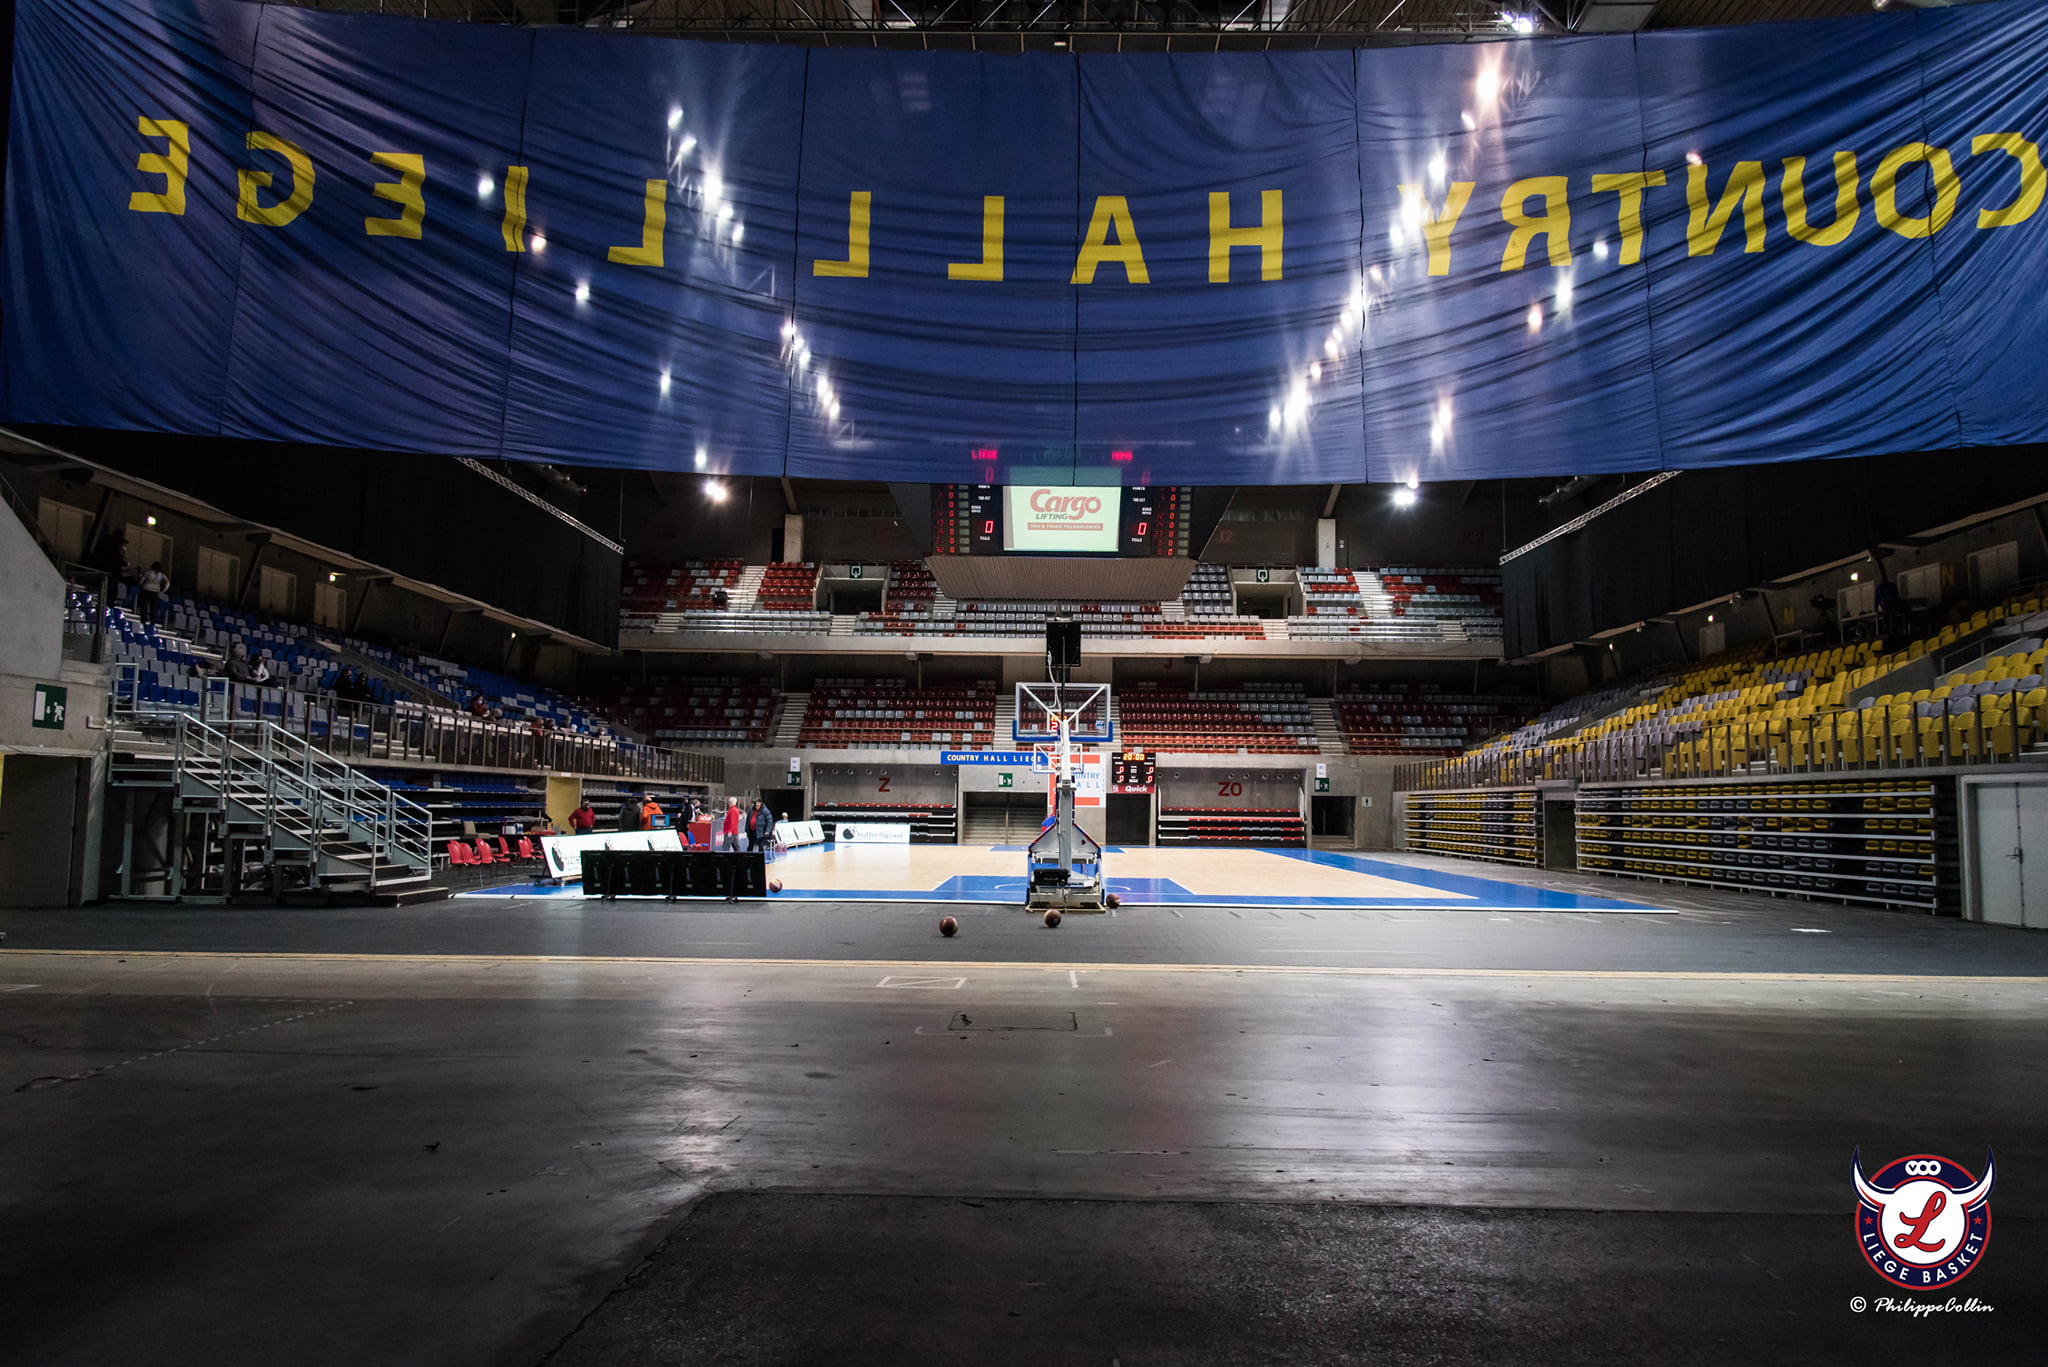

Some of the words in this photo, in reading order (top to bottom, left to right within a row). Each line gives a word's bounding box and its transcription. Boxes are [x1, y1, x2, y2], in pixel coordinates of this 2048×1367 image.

[1030, 488, 1102, 520] Cargo
[984, 520, 994, 534] 0
[1137, 522, 1147, 536] 0
[946, 754, 979, 762] COUNTRY
[1122, 753, 1145, 761] 20:00
[878, 777, 891, 793] Z
[1076, 781, 1100, 789] ALL
[1125, 785, 1148, 793] Quick
[1217, 781, 1243, 797] ZO
